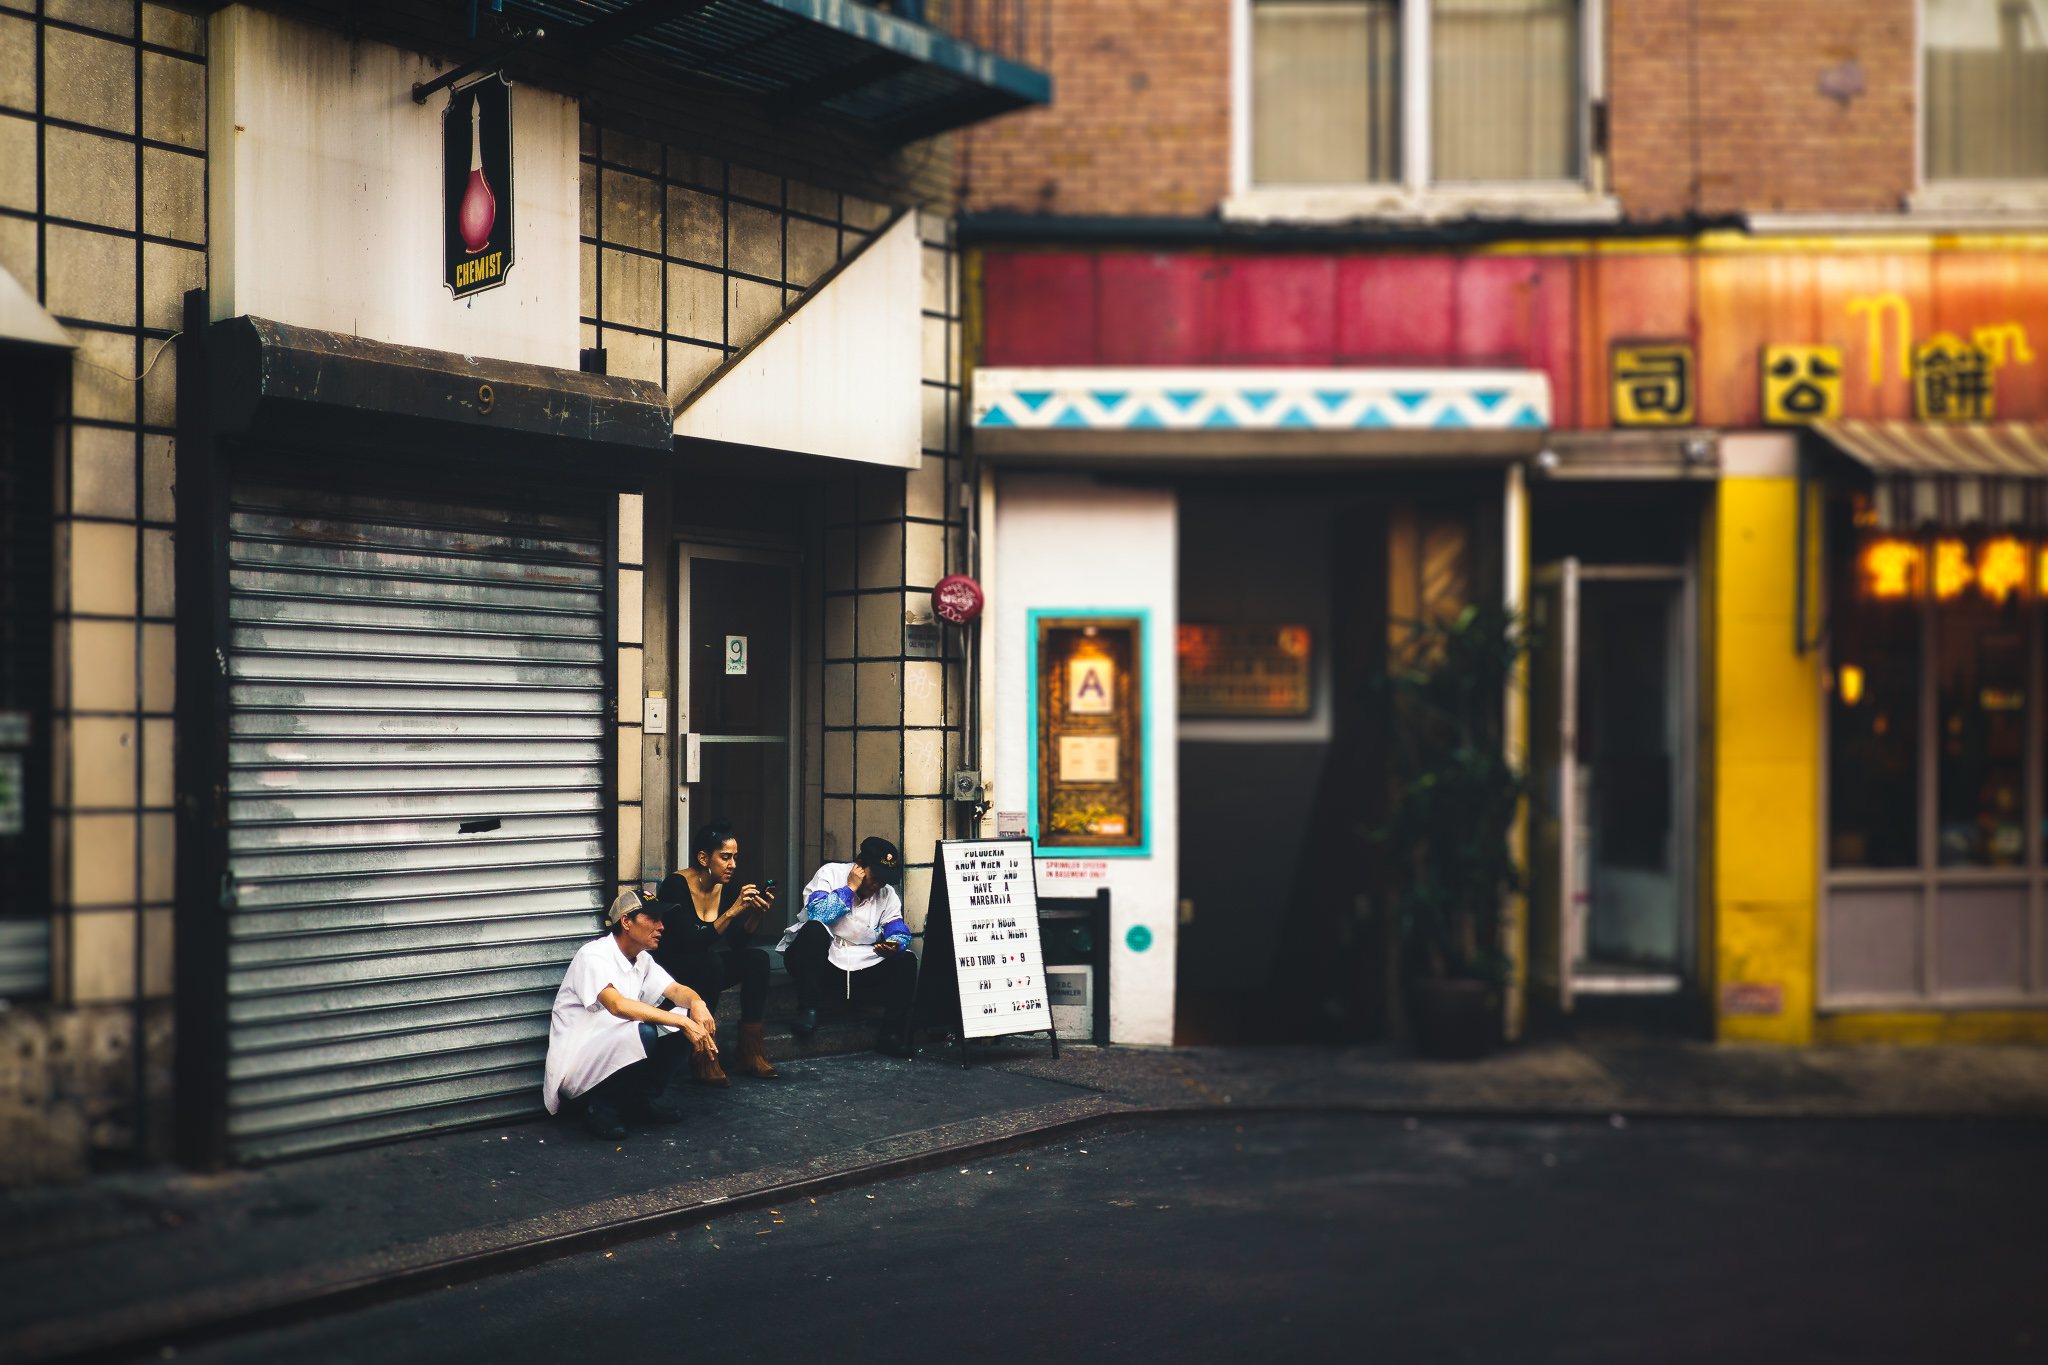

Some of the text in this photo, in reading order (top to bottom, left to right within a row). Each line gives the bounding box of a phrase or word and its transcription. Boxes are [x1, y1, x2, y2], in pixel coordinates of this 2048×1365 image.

[456, 252, 502, 288] CHEMIST
[478, 384, 495, 415] 9
[729, 639, 743, 664] 9
[1077, 667, 1105, 698] A
[954, 859, 976, 871] KNOW
[980, 859, 1001, 869] WHEN
[973, 881, 1010, 894] HAVE A
[969, 894, 1012, 906] MARGARITA
[998, 917, 1016, 929] HOUR
[990, 930, 1005, 941] ALL
[959, 952, 1027, 968] WED THUR 5 9
[979, 979, 992, 990] FRI
[1025, 975, 1032, 986] 7
